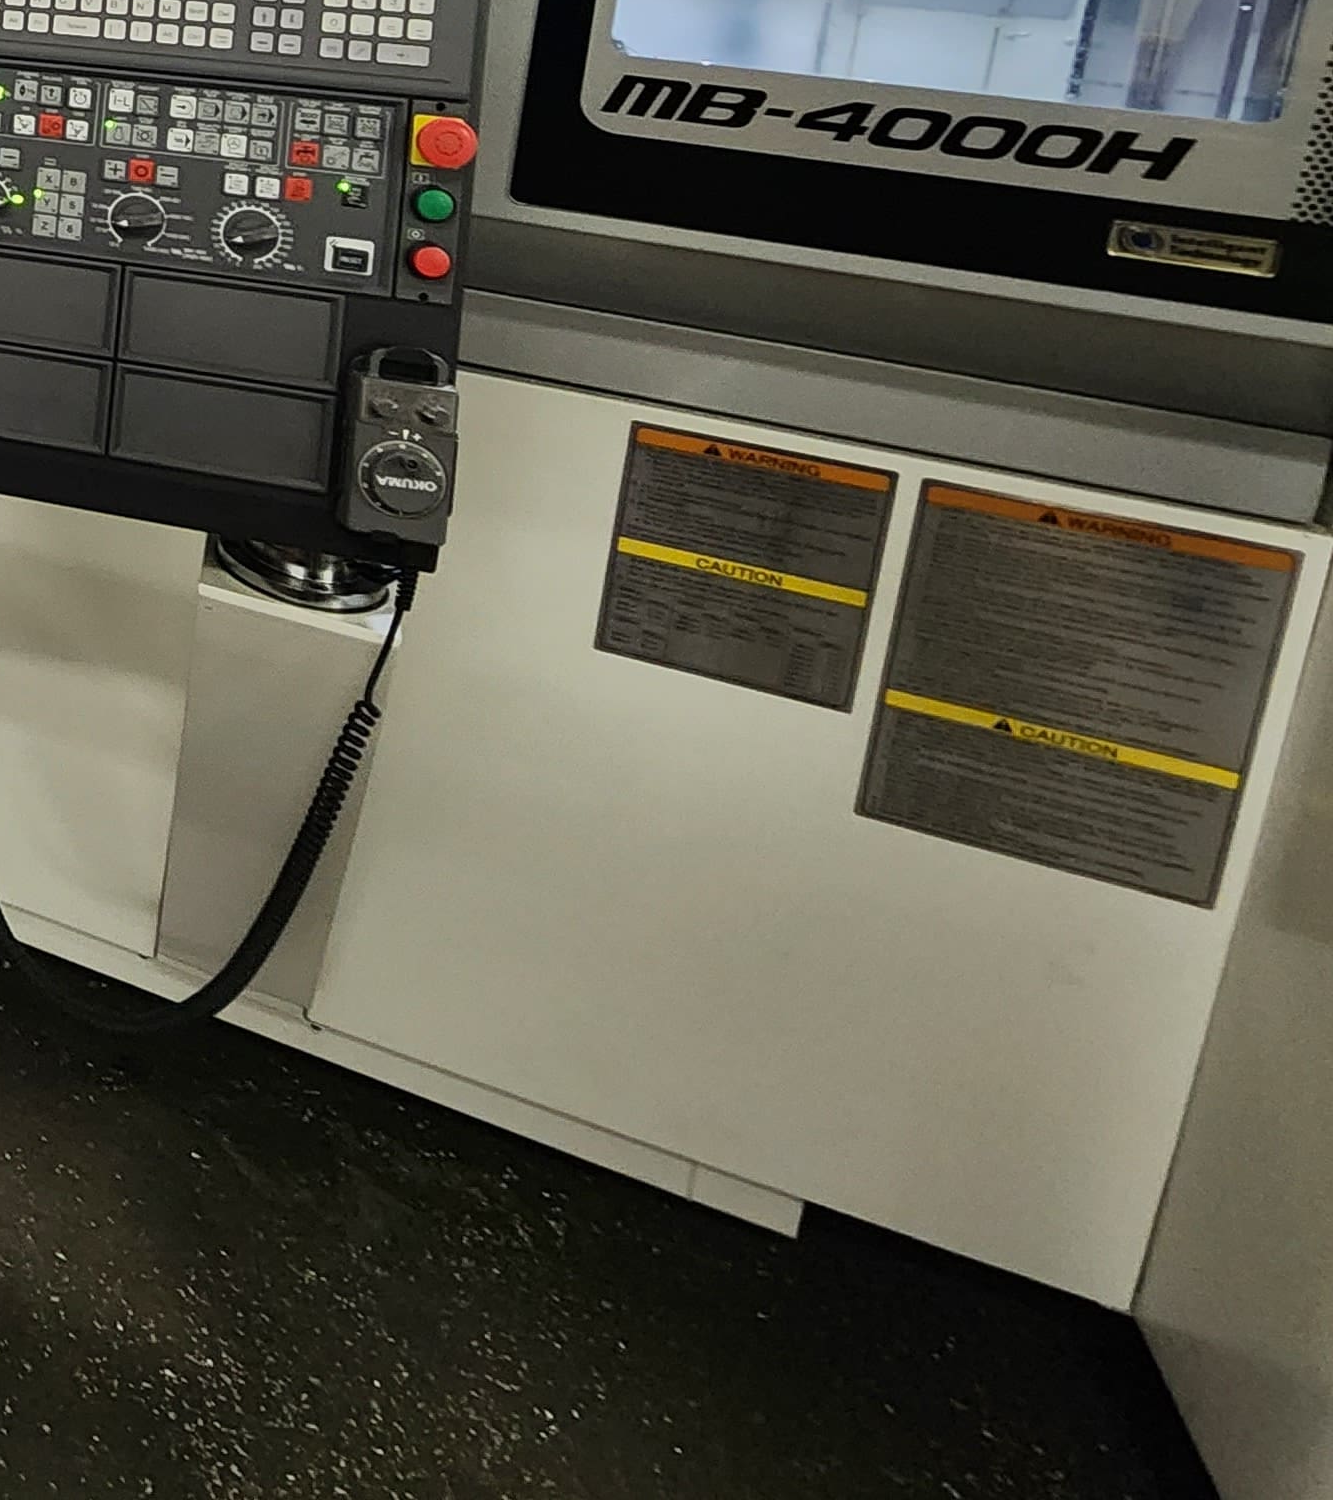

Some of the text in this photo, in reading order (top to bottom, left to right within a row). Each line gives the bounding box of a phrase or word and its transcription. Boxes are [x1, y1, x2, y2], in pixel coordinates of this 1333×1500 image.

[600, 74, 1197, 181] MB-4000H
[728, 447, 821, 477] WARNING
[375, 474, 438, 492] OKUMA
[1066, 515, 1173, 549] WARNING
[695, 557, 783, 587] CAUTION
[1019, 725, 1119, 759] CAUTION
